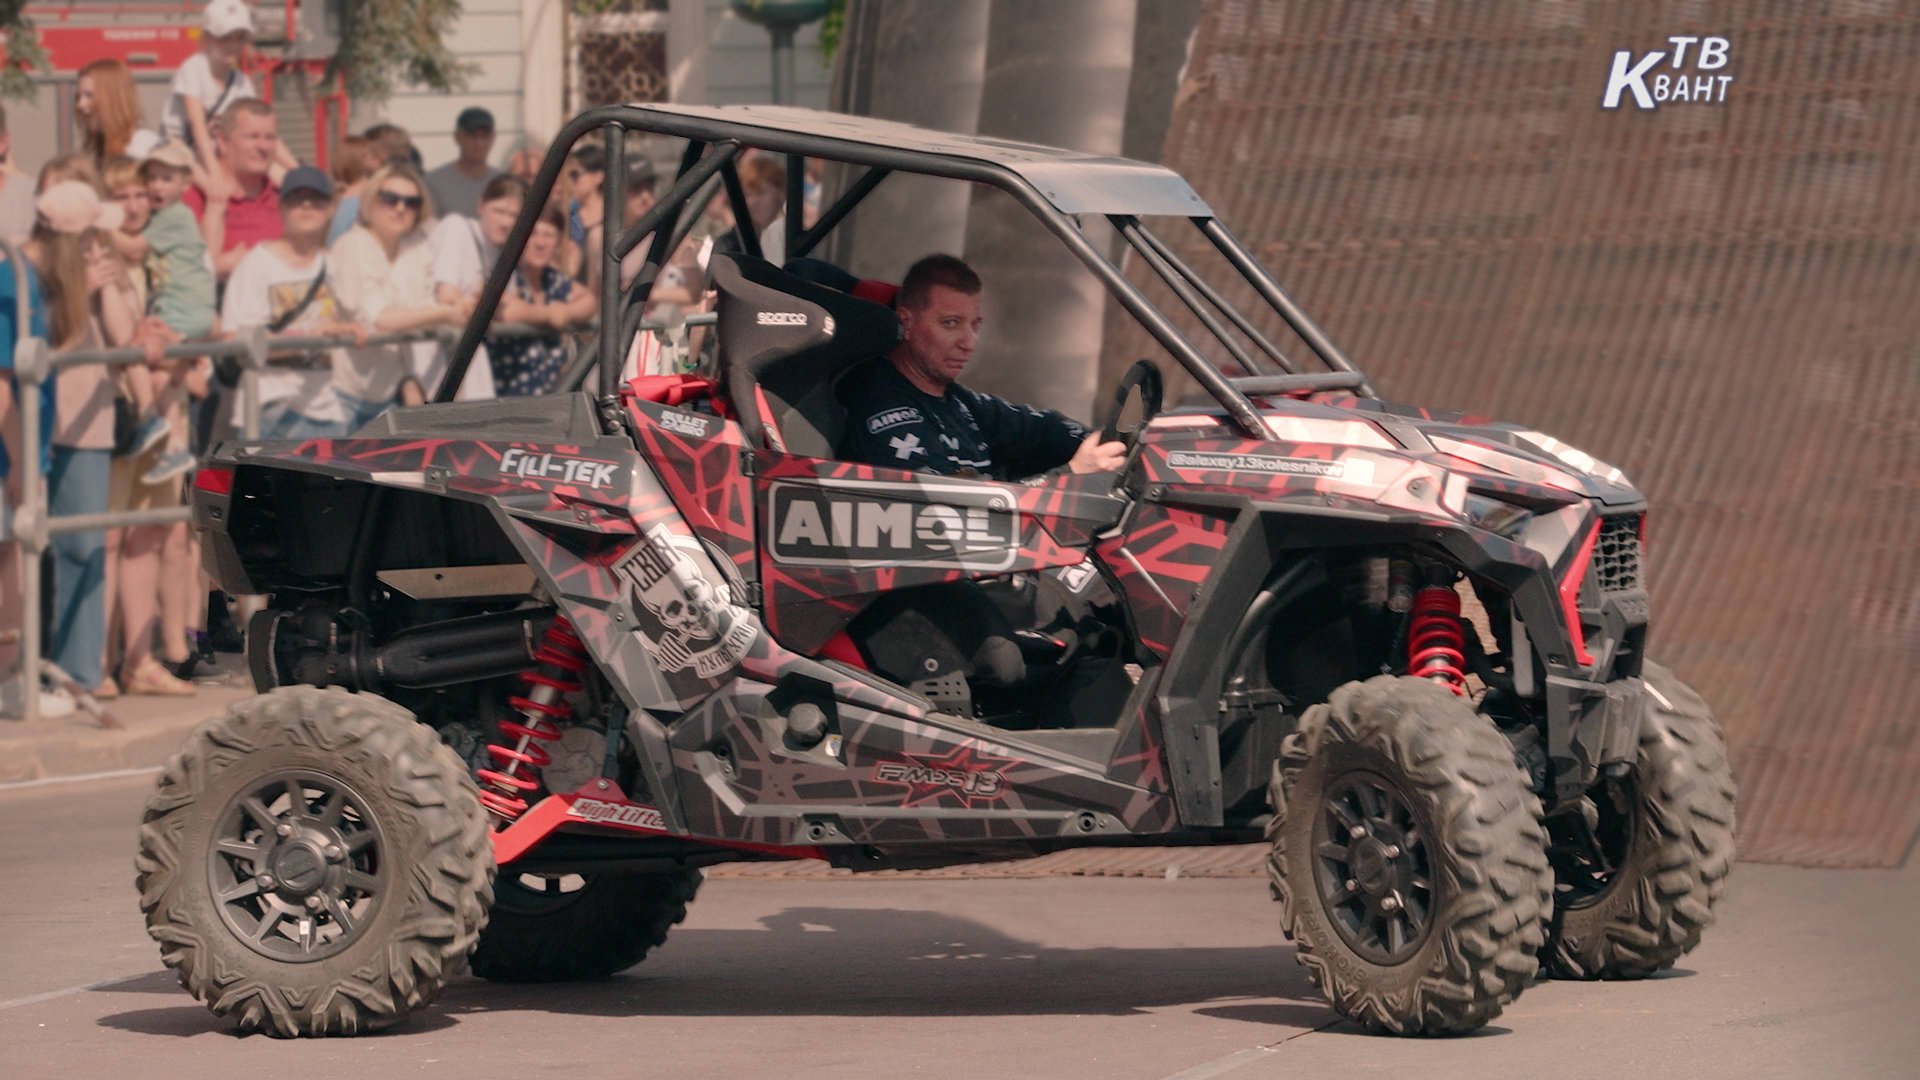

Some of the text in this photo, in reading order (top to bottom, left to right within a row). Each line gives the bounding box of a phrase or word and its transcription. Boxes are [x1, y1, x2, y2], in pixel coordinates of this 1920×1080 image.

[757, 312, 807, 325] sparco
[574, 800, 666, 828] High Lifte
